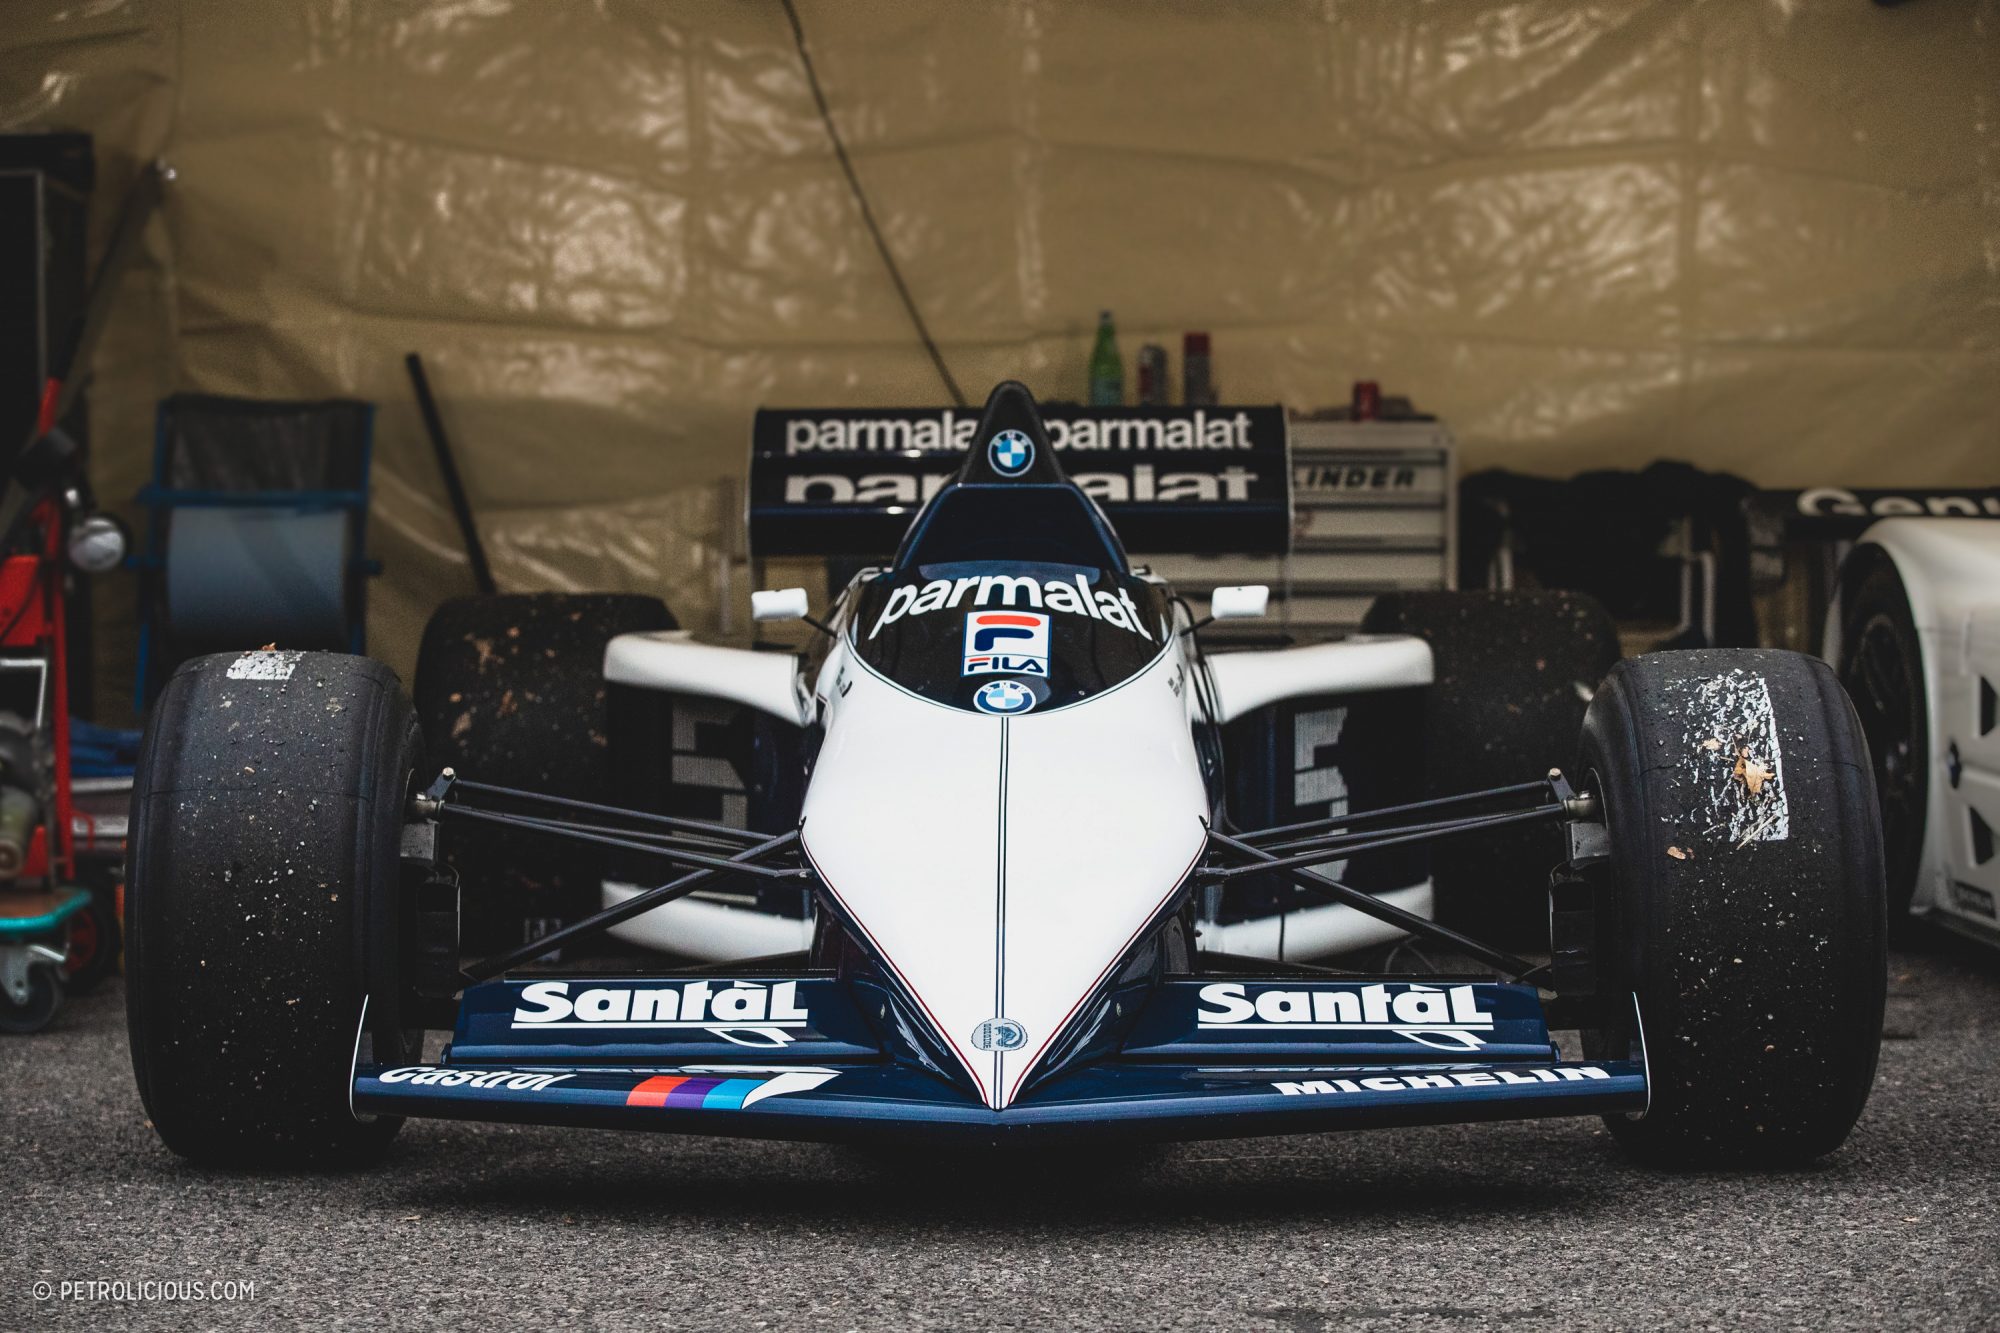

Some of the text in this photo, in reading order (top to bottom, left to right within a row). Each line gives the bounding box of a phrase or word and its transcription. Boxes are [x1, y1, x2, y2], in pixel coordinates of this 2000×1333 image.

[786, 410, 979, 457] parmala
[1293, 465, 1416, 488] INDER
[867, 573, 1153, 641] parmalat
[967, 656, 1045, 674] FILA
[379, 1066, 577, 1091] Castrol
[1271, 1066, 1611, 1096] MICHELIN
